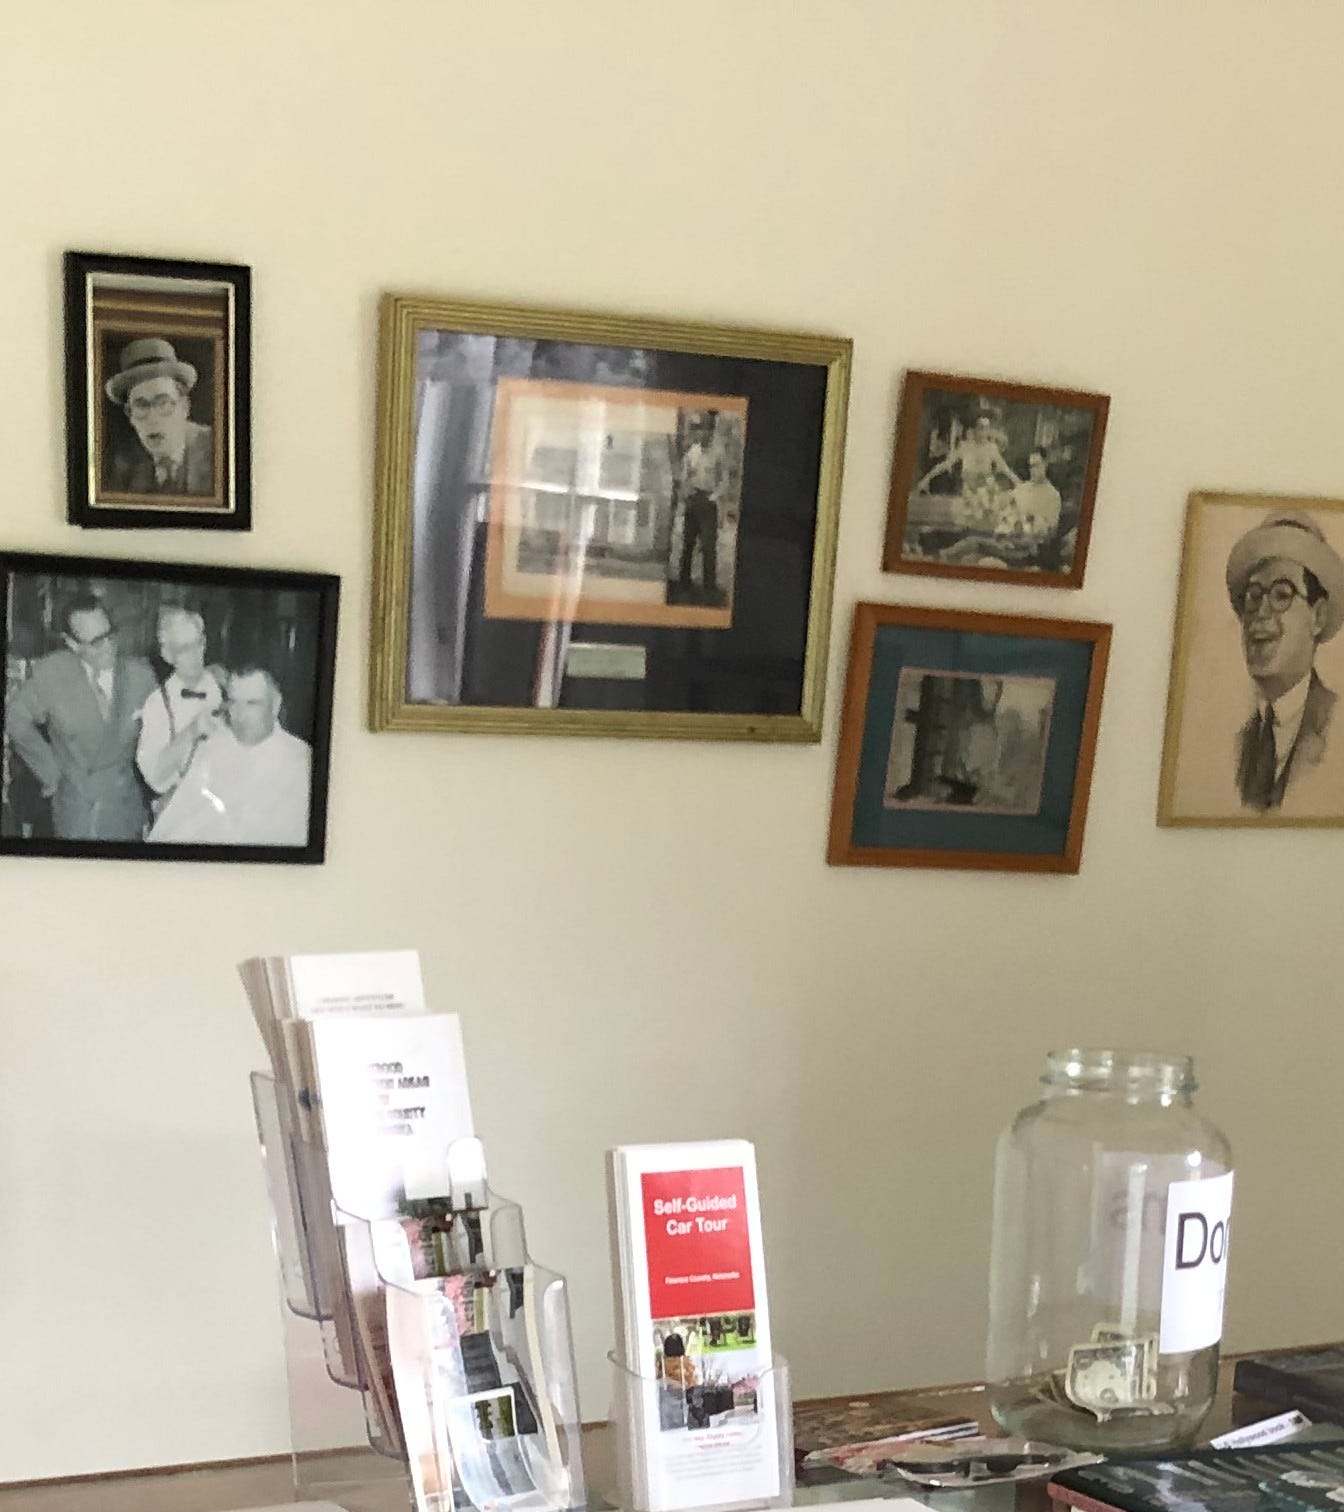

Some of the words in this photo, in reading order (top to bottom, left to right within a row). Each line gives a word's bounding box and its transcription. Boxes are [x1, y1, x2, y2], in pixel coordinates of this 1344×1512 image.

[654, 1193, 737, 1216] Self-Guided
[666, 1219, 693, 1236] Car
[695, 1217, 728, 1233] Tour
